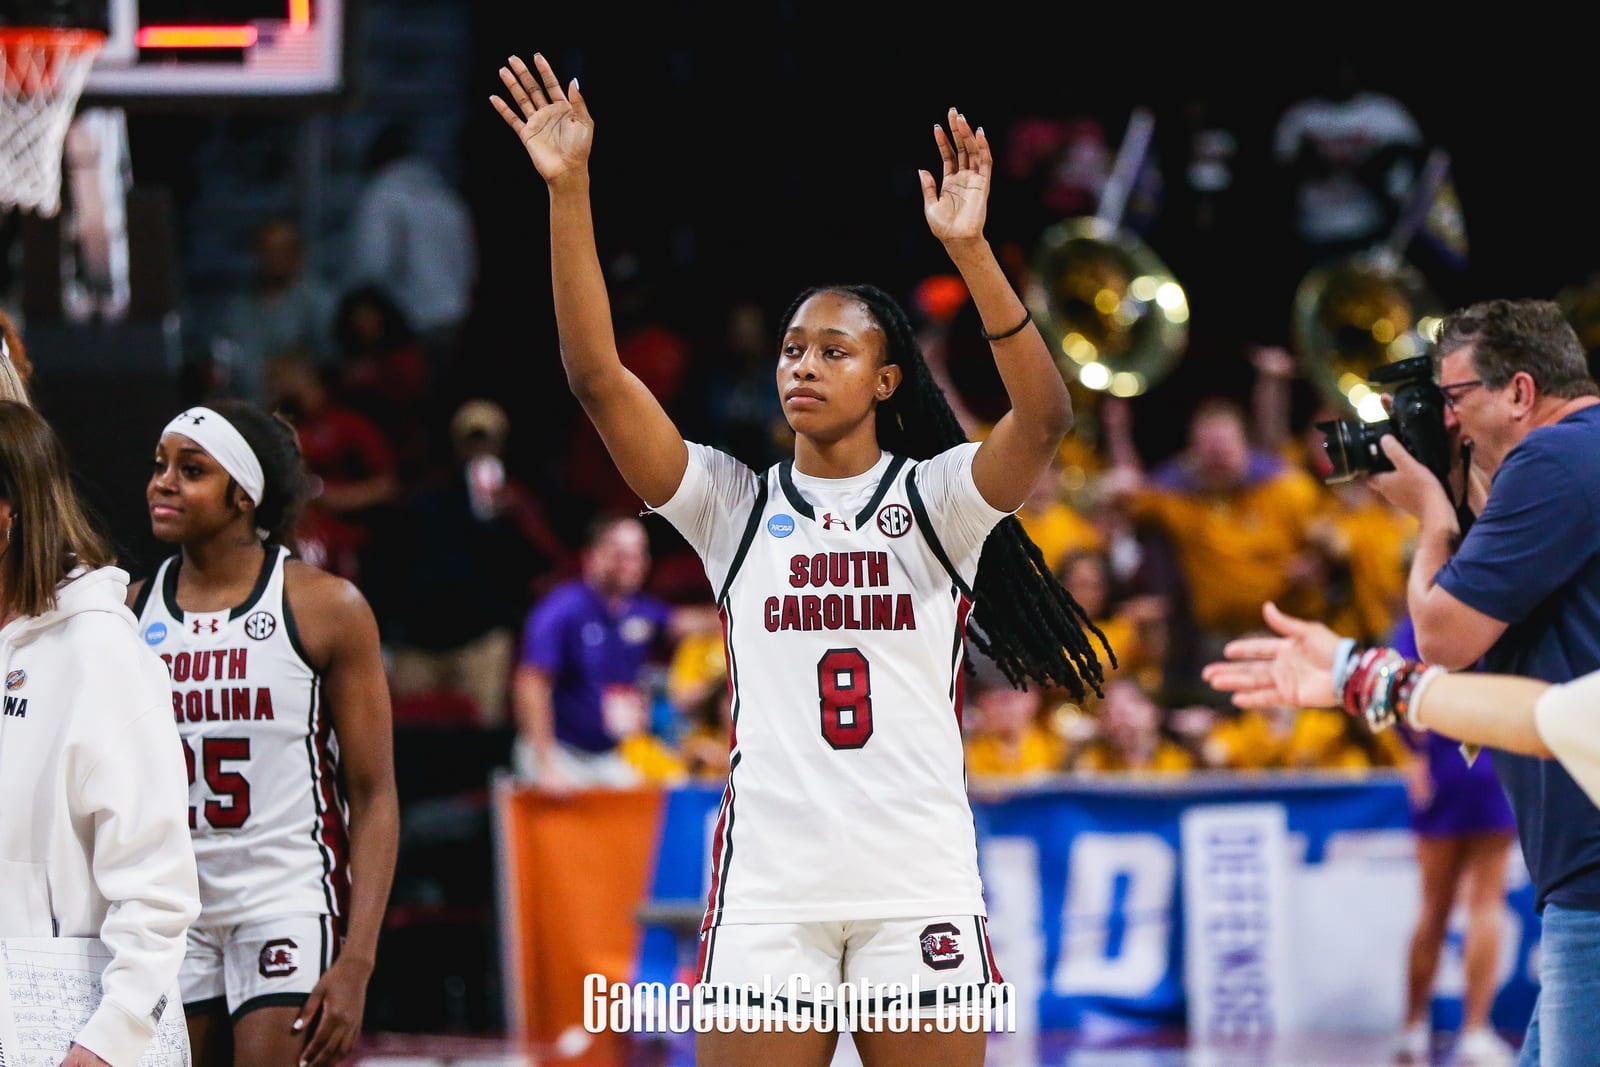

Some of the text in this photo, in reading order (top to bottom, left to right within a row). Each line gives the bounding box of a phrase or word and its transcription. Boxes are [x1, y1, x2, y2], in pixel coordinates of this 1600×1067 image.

[879, 506, 909, 536] SEC
[789, 551, 890, 588] SOUTH
[764, 594, 916, 632] CAROLINA
[817, 648, 873, 750] 8
